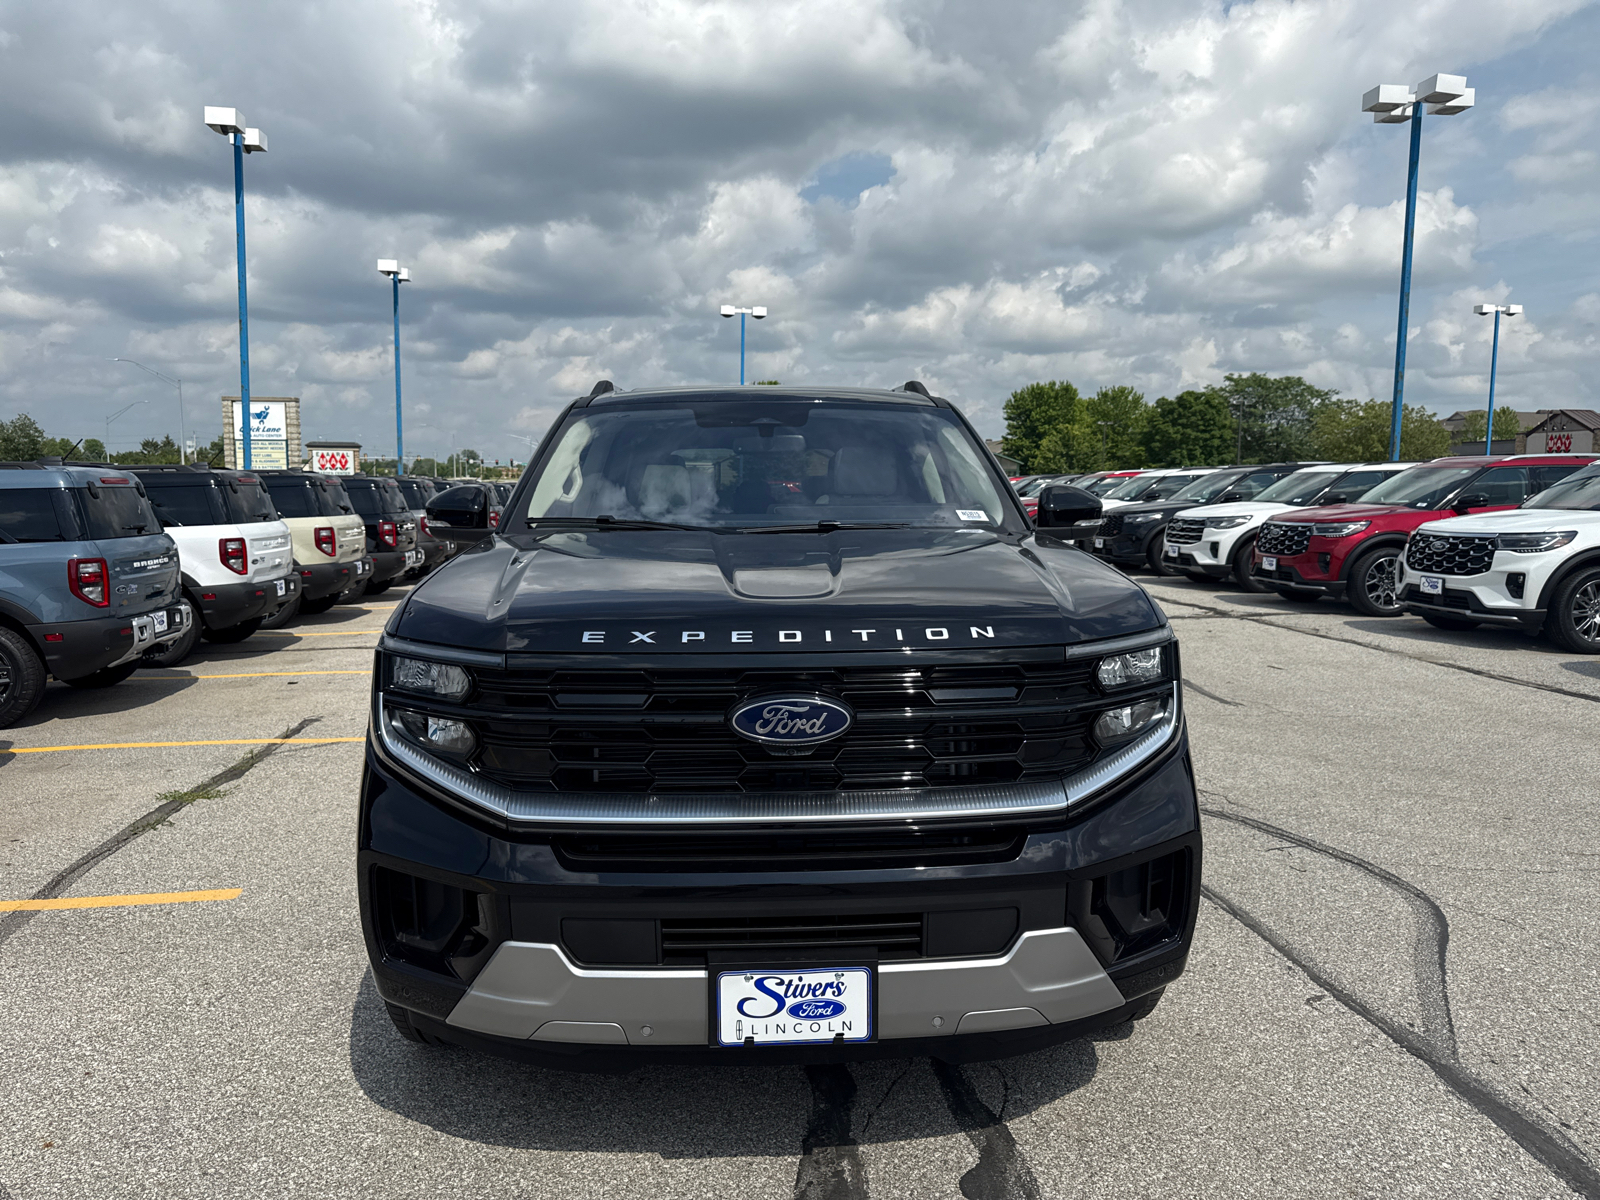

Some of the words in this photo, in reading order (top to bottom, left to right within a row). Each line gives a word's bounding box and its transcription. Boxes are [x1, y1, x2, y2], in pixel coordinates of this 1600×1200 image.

[133, 557, 169, 568] BRONCO
[582, 625, 995, 644] EXPEDITION
[755, 704, 828, 735] Ford
[736, 976, 847, 1018] Stivers
[799, 1002, 834, 1016] Ford
[751, 1020, 852, 1034] LINCOLN
